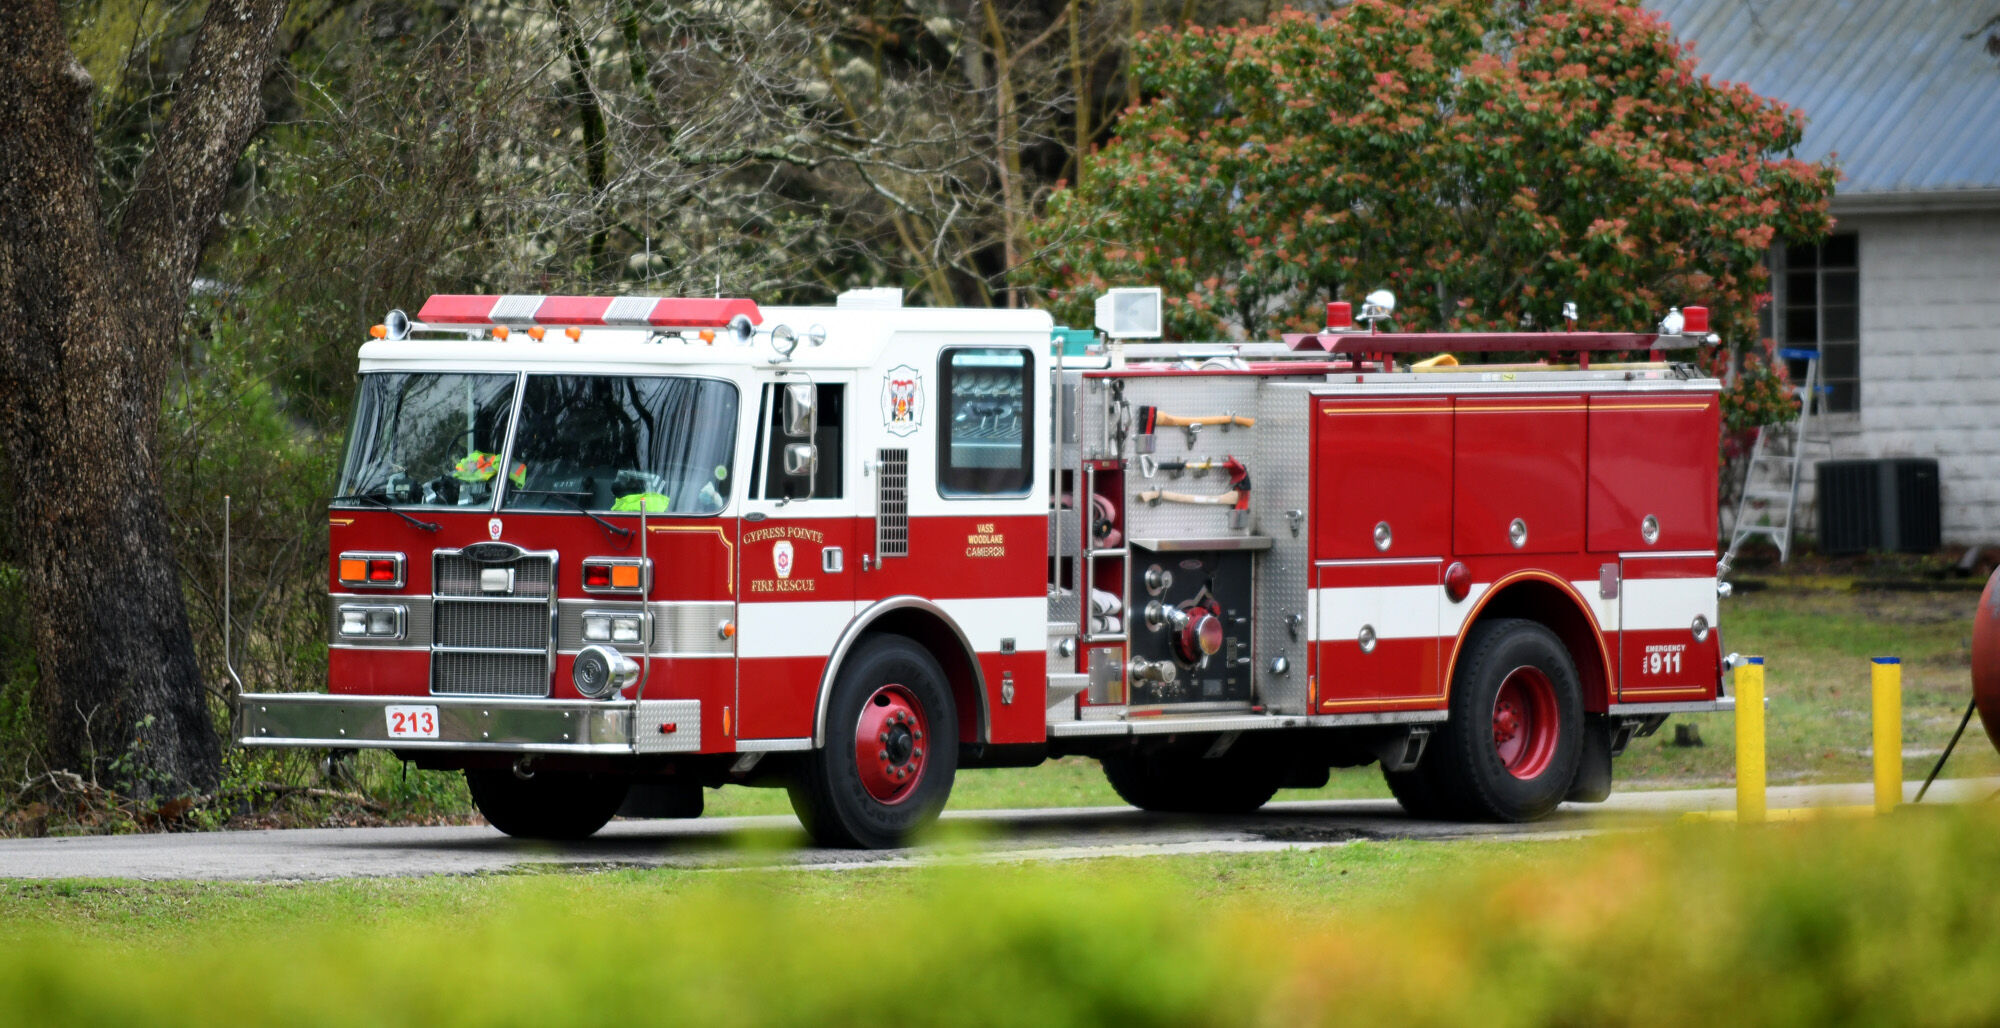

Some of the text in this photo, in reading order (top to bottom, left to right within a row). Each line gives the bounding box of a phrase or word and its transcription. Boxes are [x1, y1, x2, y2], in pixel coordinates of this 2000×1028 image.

[977, 523, 994, 533] VASS
[743, 526, 824, 545] CYPRESS POINTE
[967, 534, 1004, 544] WOODLAKE
[965, 546, 1005, 557] CAMERON
[751, 579, 815, 592] FIRE RESCUE
[1645, 644, 1686, 653] EMERGENCY
[1650, 652, 1681, 674] 911
[391, 711, 434, 734] 213
